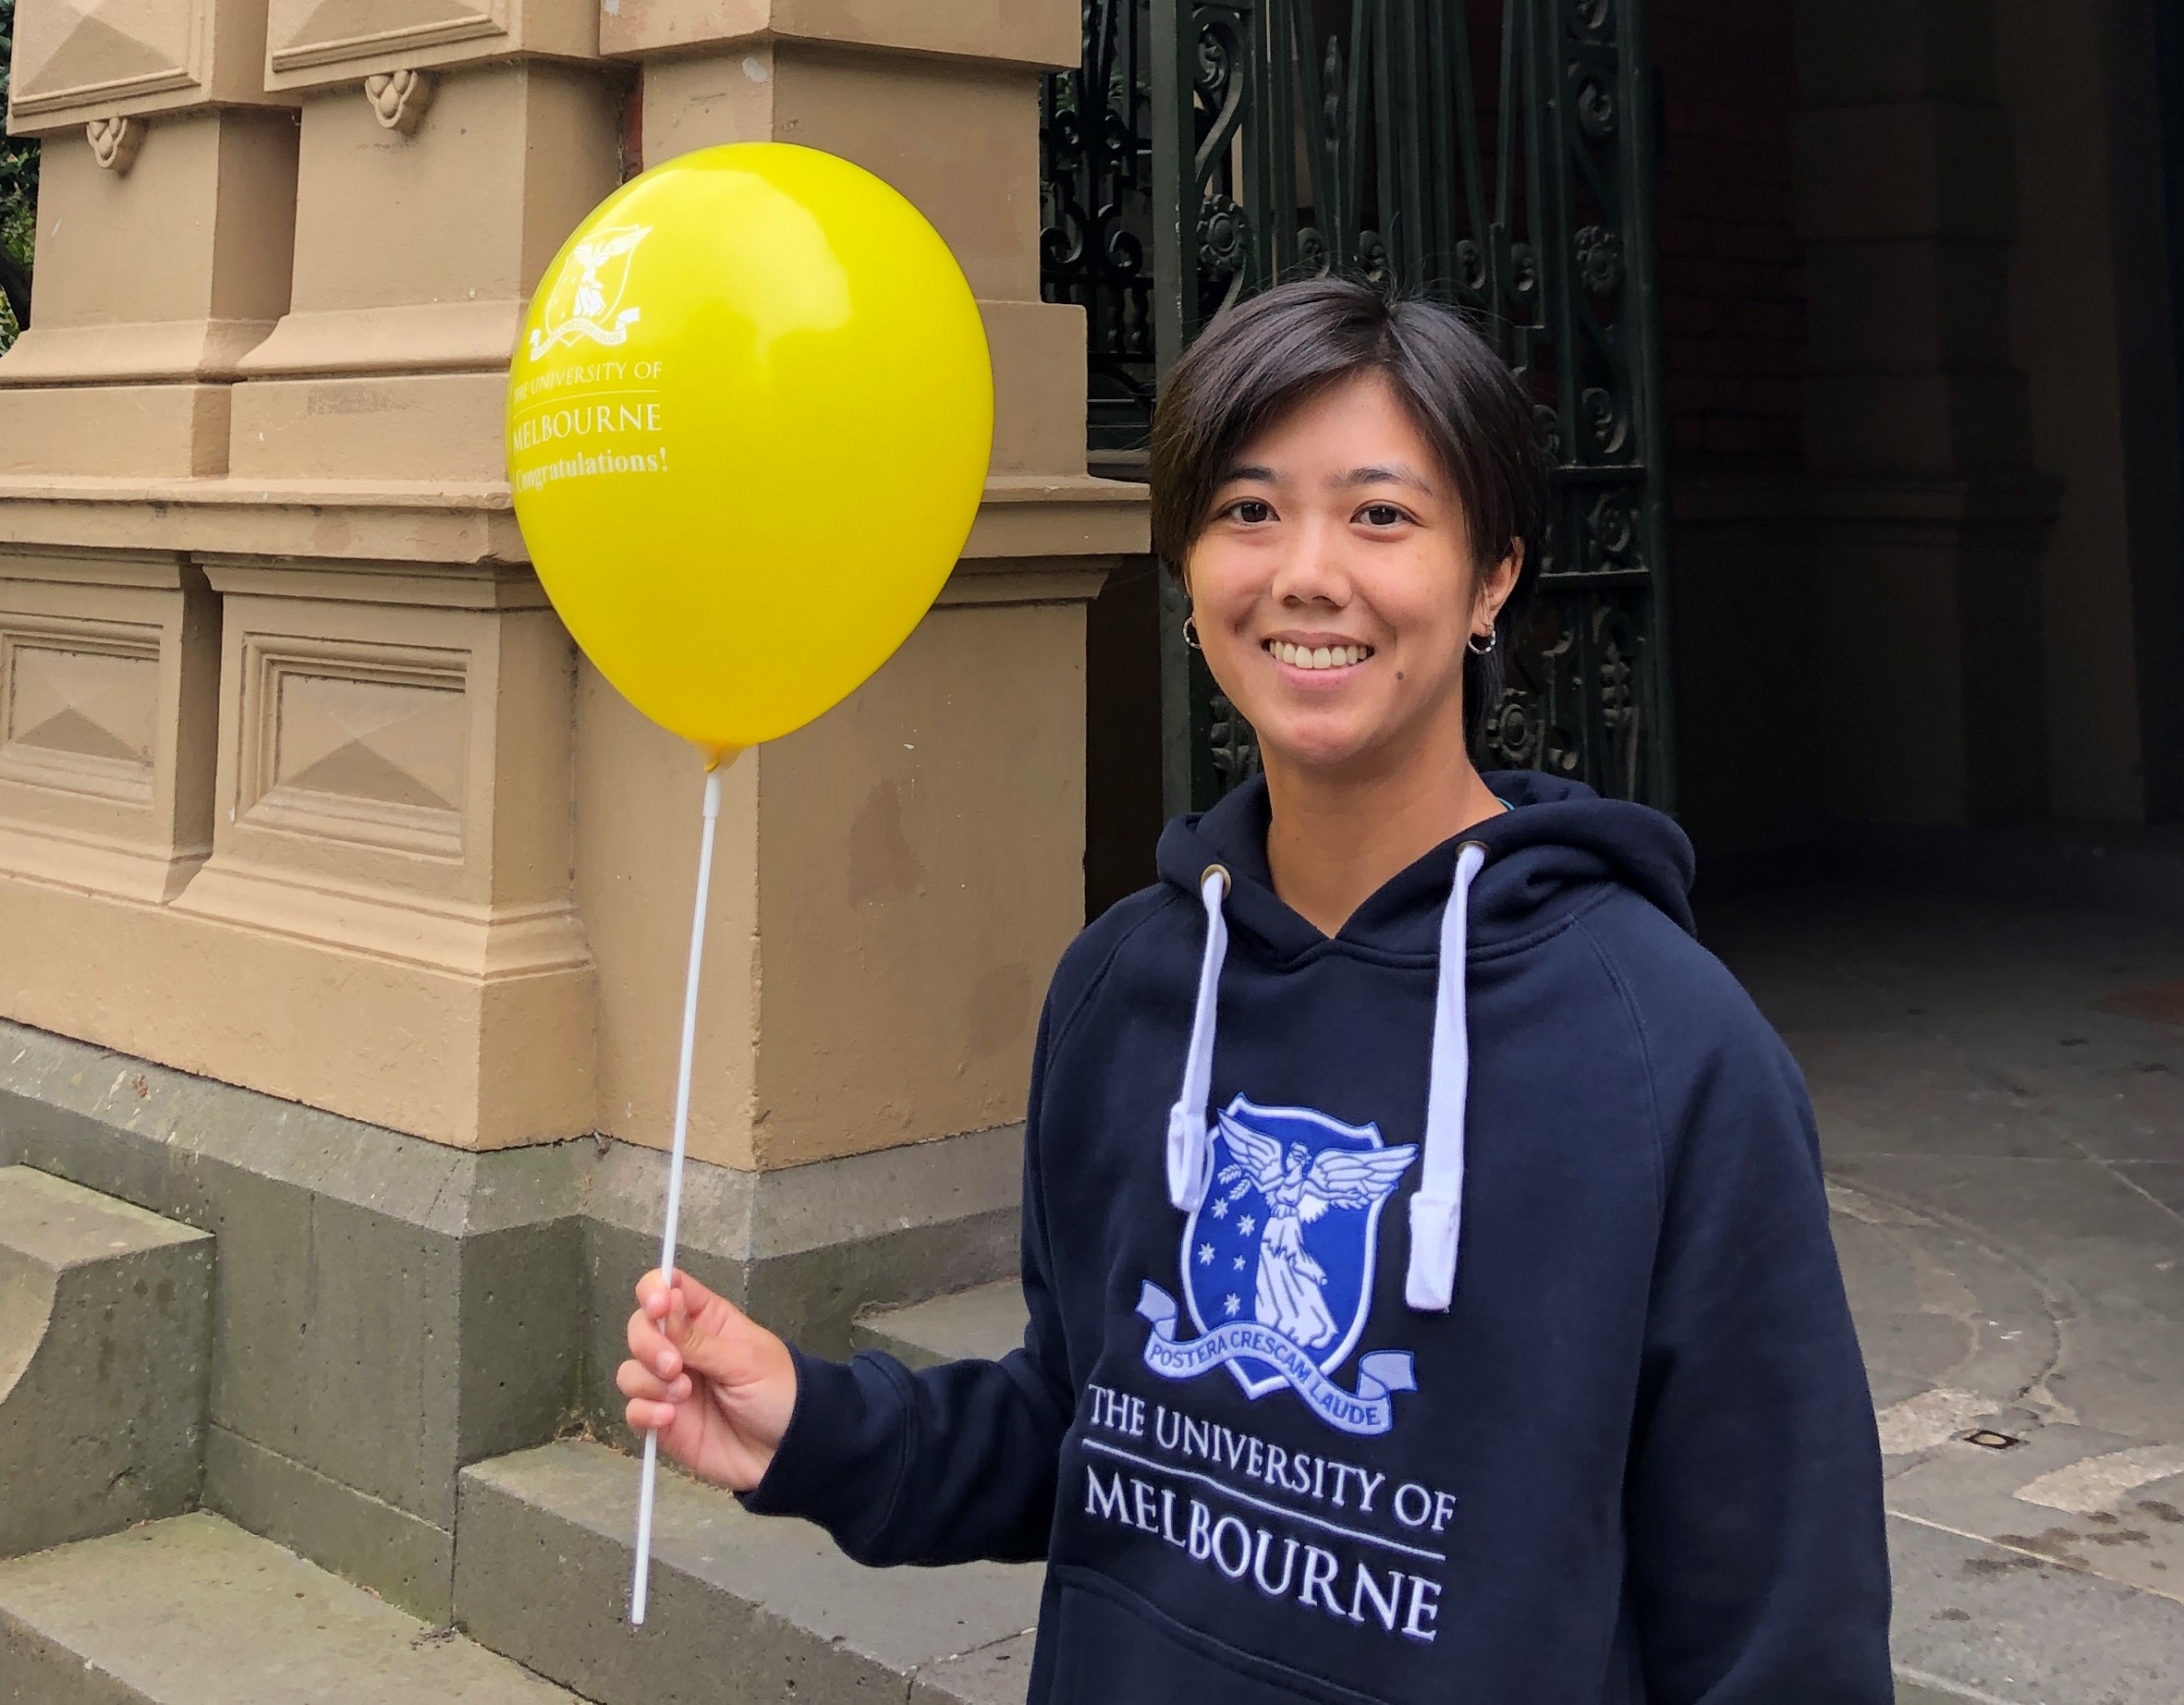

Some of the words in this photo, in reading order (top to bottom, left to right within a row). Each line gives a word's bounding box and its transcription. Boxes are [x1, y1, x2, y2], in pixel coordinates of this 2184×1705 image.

[514, 381, 528, 404] THE
[531, 361, 627, 395] UNIVERSITY
[634, 361, 663, 380] OF
[513, 404, 661, 451] MELBOURNE
[516, 446, 668, 493] Congratulations!
[1149, 1334, 1228, 1369] POSTERA
[1230, 1331, 1312, 1384] CRESCAM
[1309, 1380, 1382, 1426] LAUDE
[1087, 1382, 1146, 1438] THE
[1154, 1406, 1386, 1513] UNIVERSITY
[1394, 1482, 1457, 1533] OF
[1084, 1465, 1445, 1642] MELBOURNE
